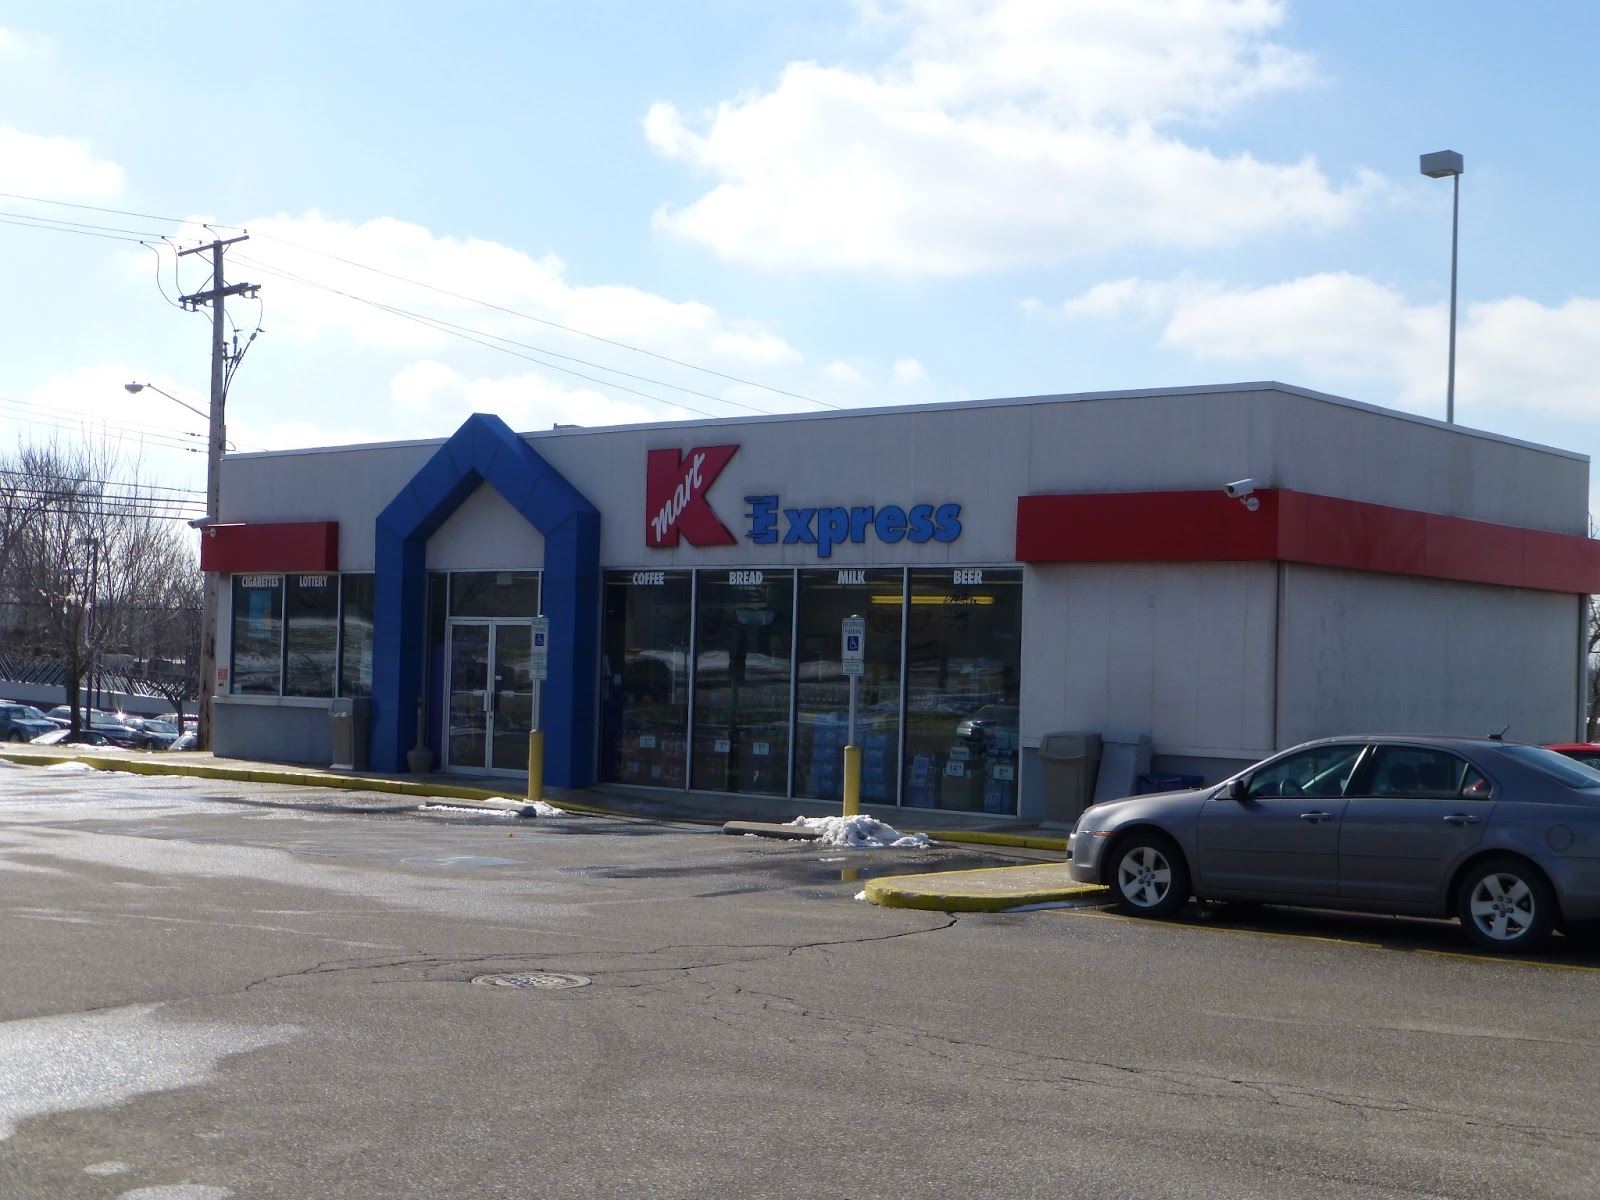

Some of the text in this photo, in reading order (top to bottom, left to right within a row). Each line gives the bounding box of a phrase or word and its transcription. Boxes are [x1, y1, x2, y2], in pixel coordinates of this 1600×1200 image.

[744, 495, 962, 558] Express
[241, 575, 279, 588] CIGARETTES
[299, 575, 328, 588] LOTTERY
[632, 572, 665, 586] COFFEE
[729, 571, 763, 586] BREAD
[837, 569, 866, 585] MILK
[953, 569, 983, 585] BEER
